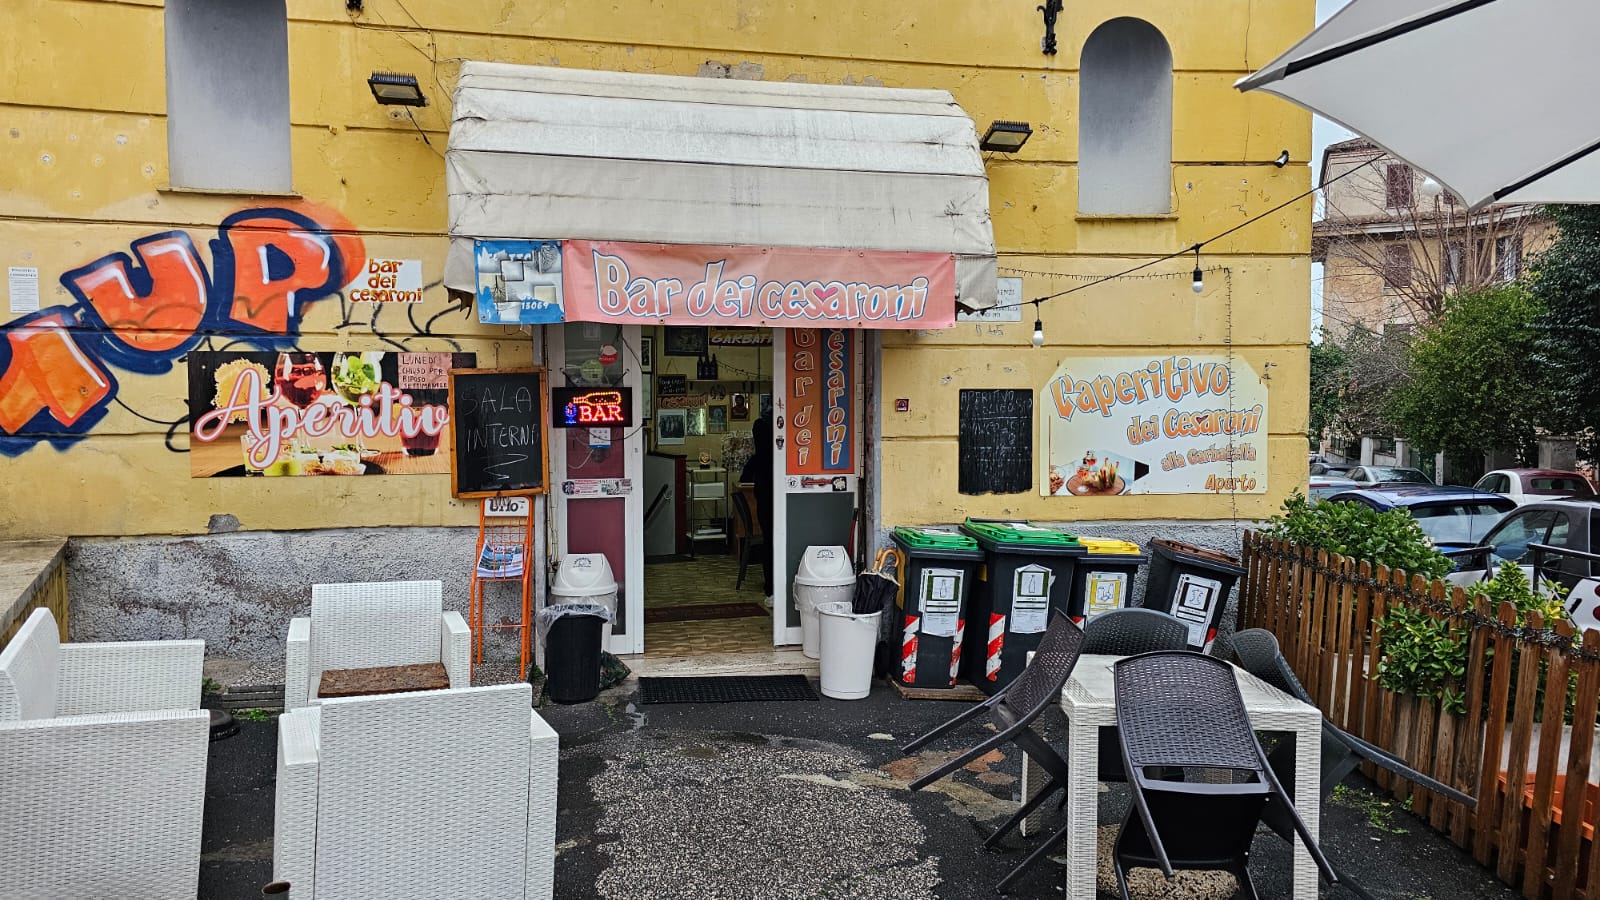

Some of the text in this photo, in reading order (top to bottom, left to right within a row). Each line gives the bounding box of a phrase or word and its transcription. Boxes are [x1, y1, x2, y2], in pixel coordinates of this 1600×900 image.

[368, 272, 397, 289] dei
[369, 258, 403, 274] bar
[349, 287, 423, 303] cesaroni
[592, 249, 929, 321] Bar dei cesaroni
[461, 385, 532, 416] SALA
[826, 327, 847, 465] esaroni
[194, 367, 450, 469] Aperitiv
[579, 405, 625, 421] BAR
[1127, 404, 1263, 445] dei Cesaroni
[793, 405, 813, 466] dei
[1160, 442, 1257, 472] alla Garbatella
[1204, 473, 1257, 493] Aperto
